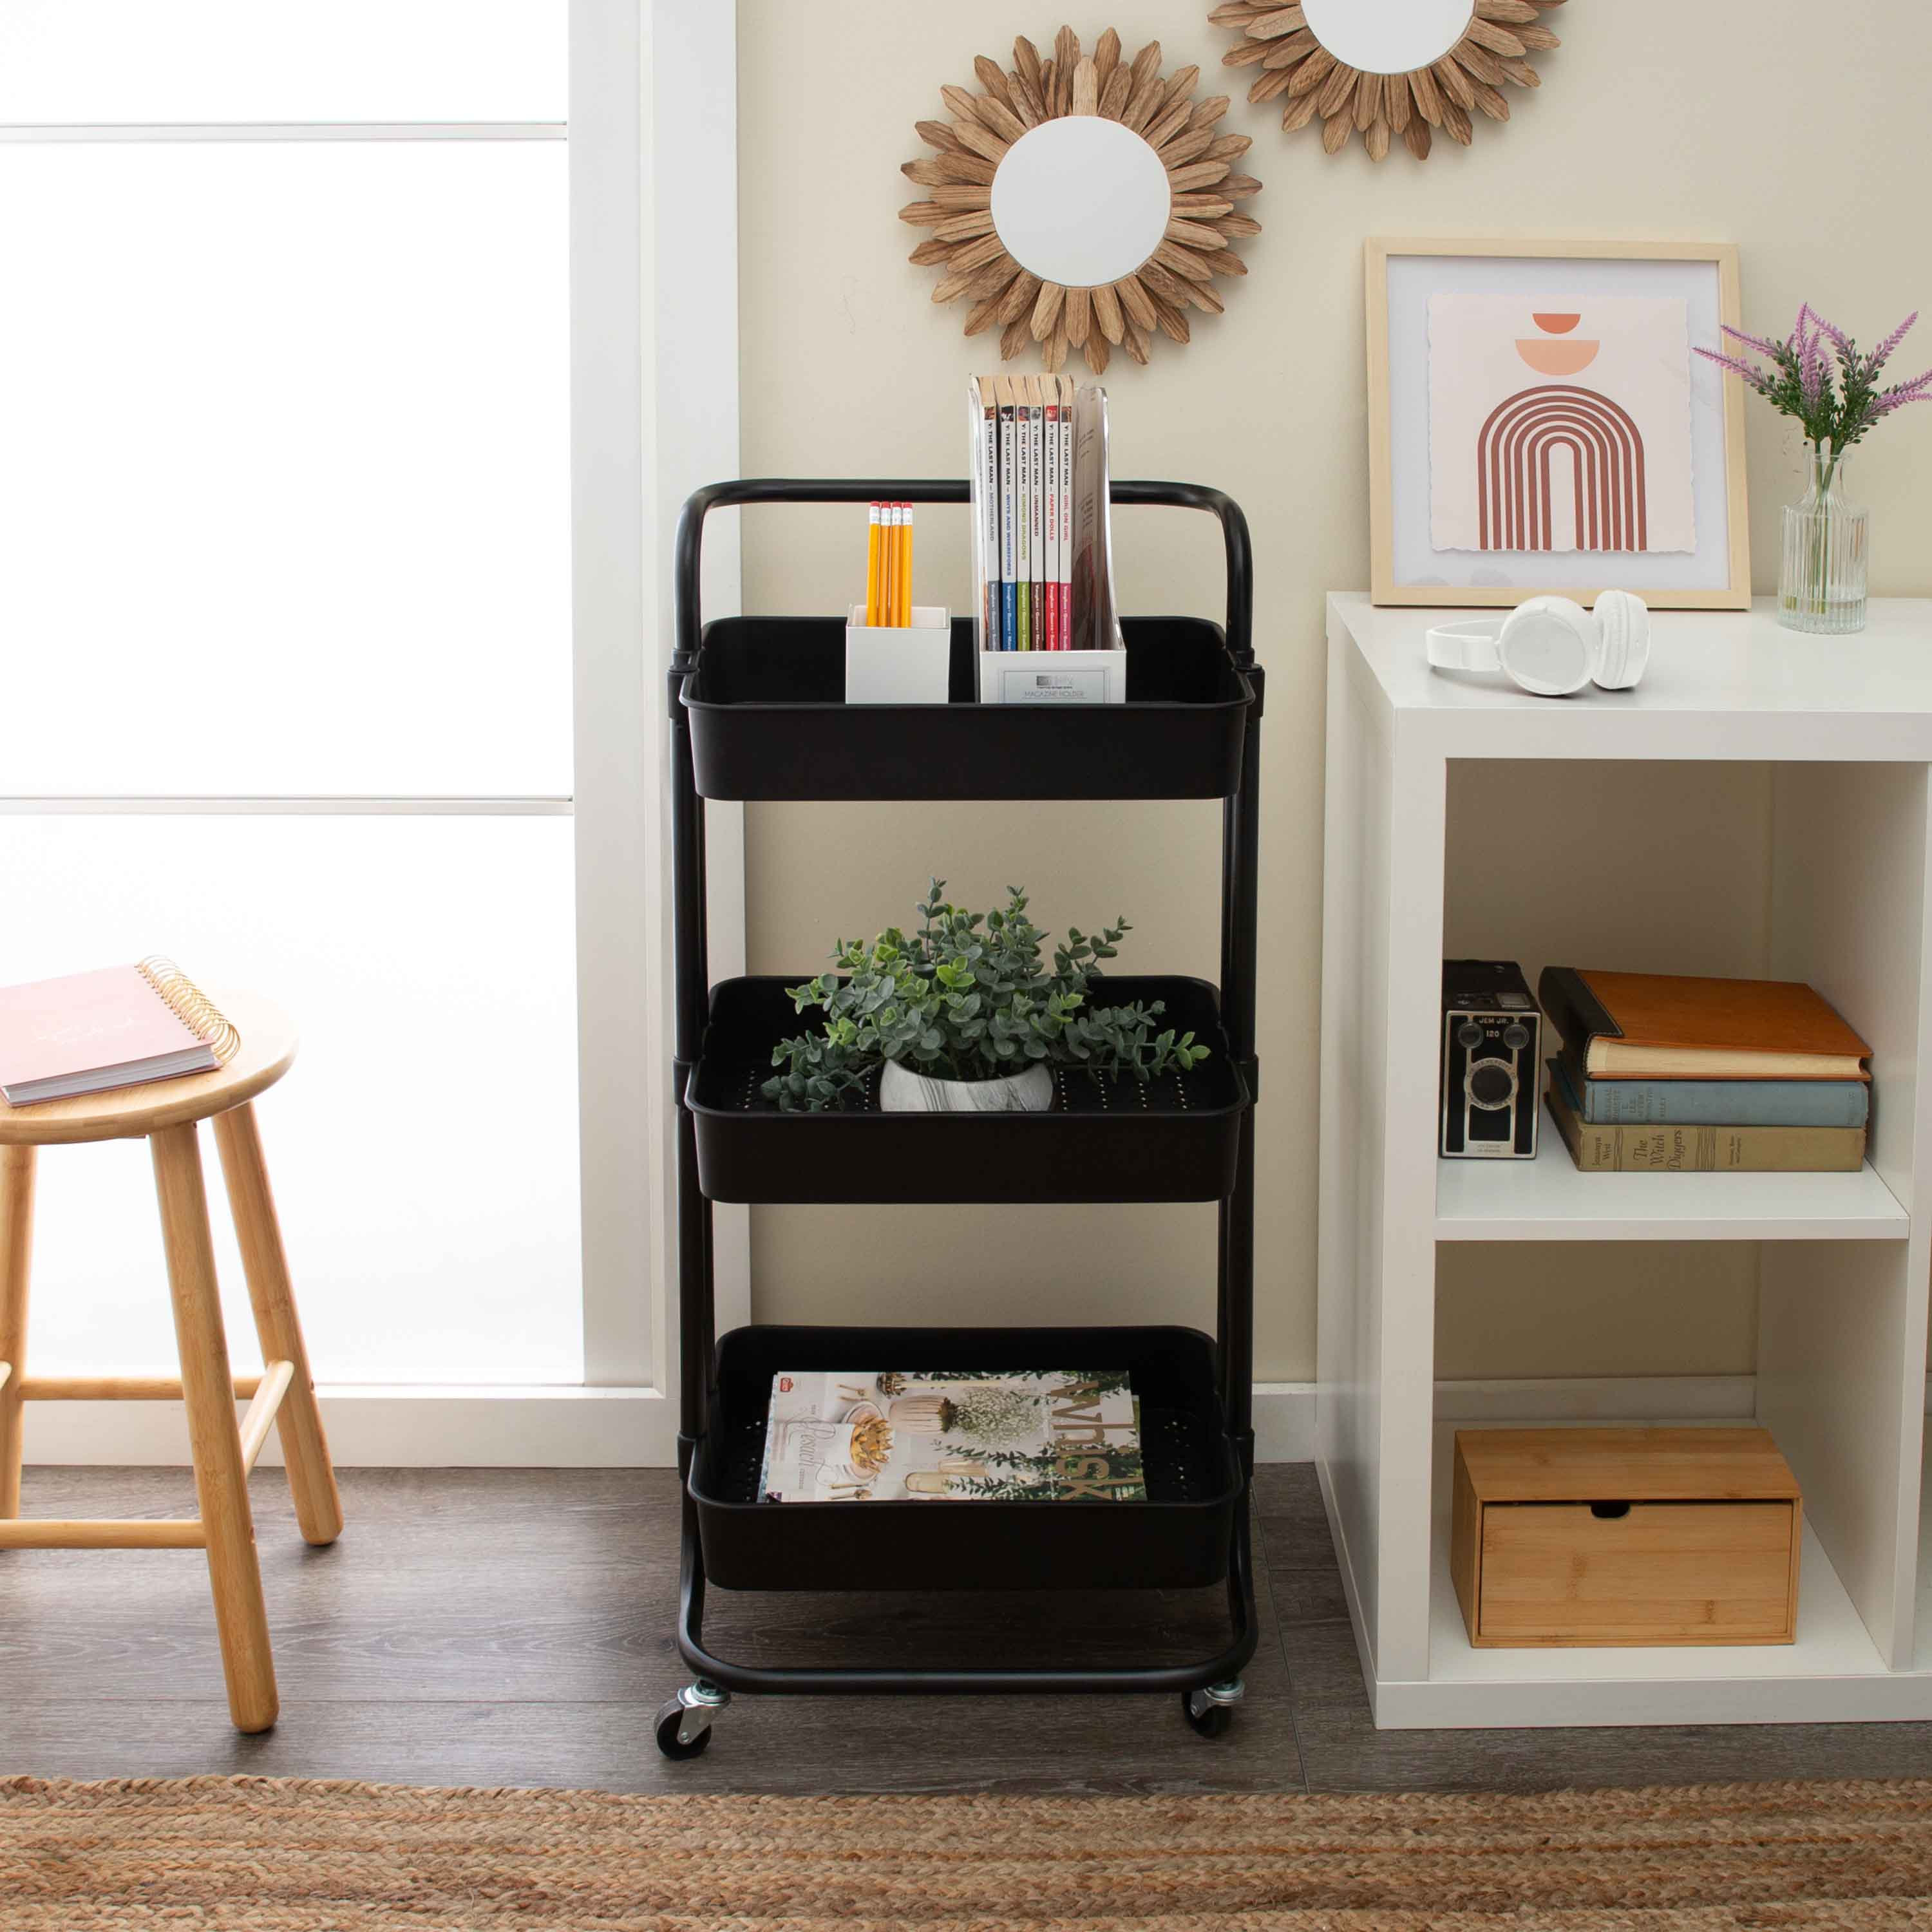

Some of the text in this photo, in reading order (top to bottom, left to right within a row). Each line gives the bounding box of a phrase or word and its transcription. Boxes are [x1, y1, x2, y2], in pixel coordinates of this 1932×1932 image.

[1063, 513, 1068, 523] ON
[1633, 1139, 1648, 1160] The
[1649, 1134, 1665, 1165] Witch
[1667, 1130, 1685, 1170] Diggers
